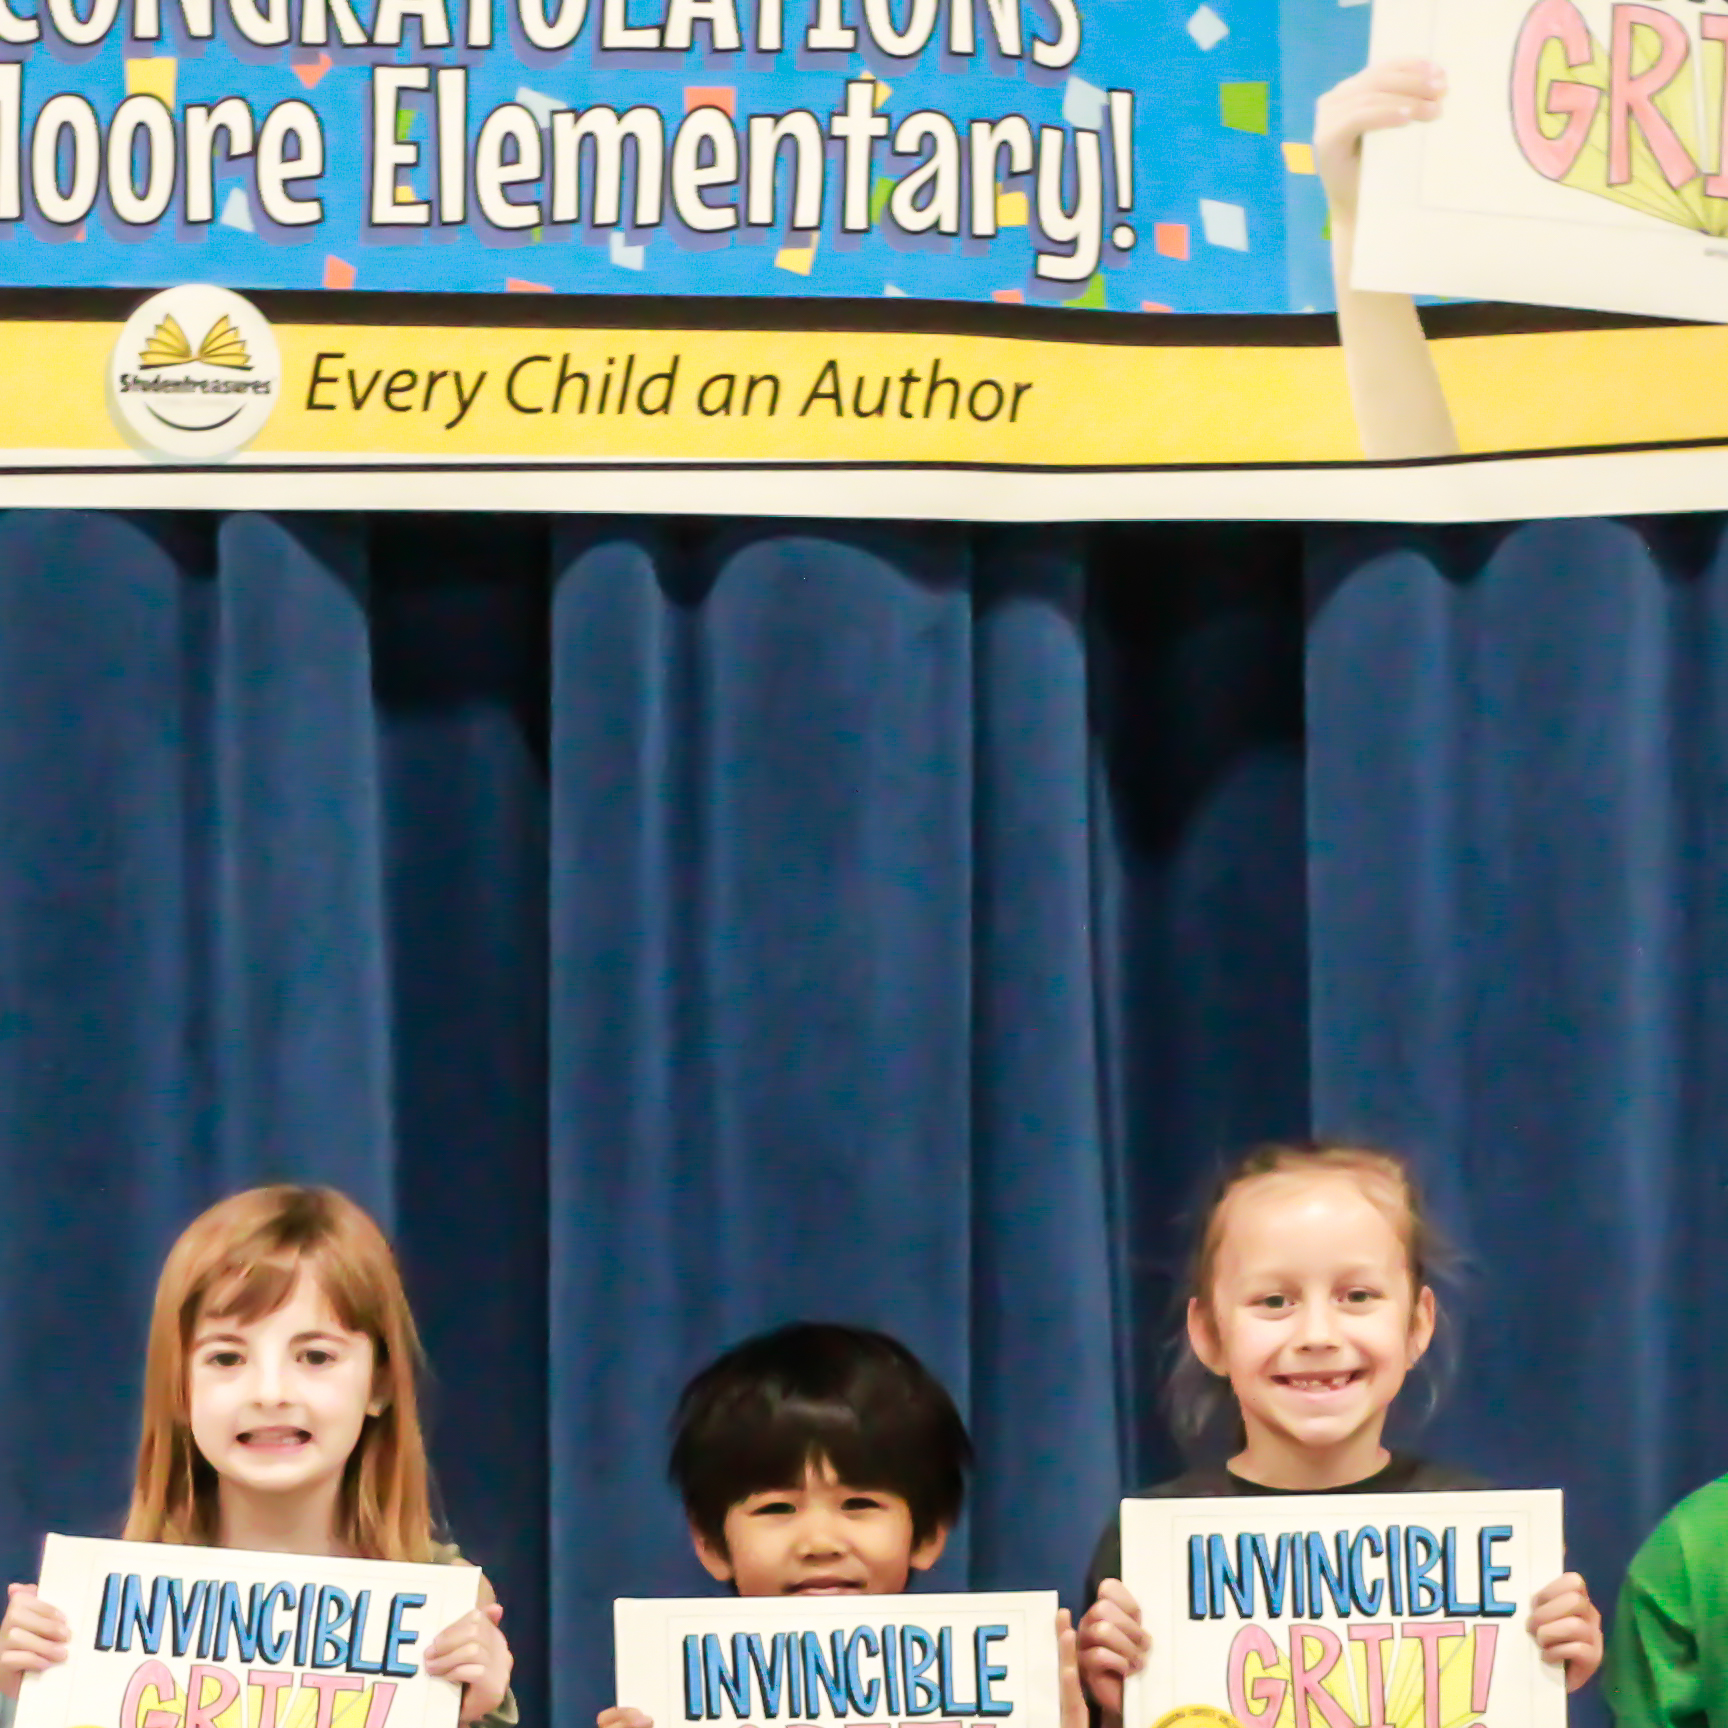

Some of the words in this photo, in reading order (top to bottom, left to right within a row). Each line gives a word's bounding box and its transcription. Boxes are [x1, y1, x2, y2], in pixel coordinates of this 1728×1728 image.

[369, 64, 1139, 284] Elementary!
[306, 352, 488, 430] Every
[505, 352, 682, 416] Child
[697, 371, 782, 418] an
[798, 358, 1034, 424] Author
[1189, 1527, 1516, 1620] INVINCIBLE
[95, 1575, 424, 1678] INVINCIBLE
[683, 1625, 1012, 1720] INVINCIBLE
